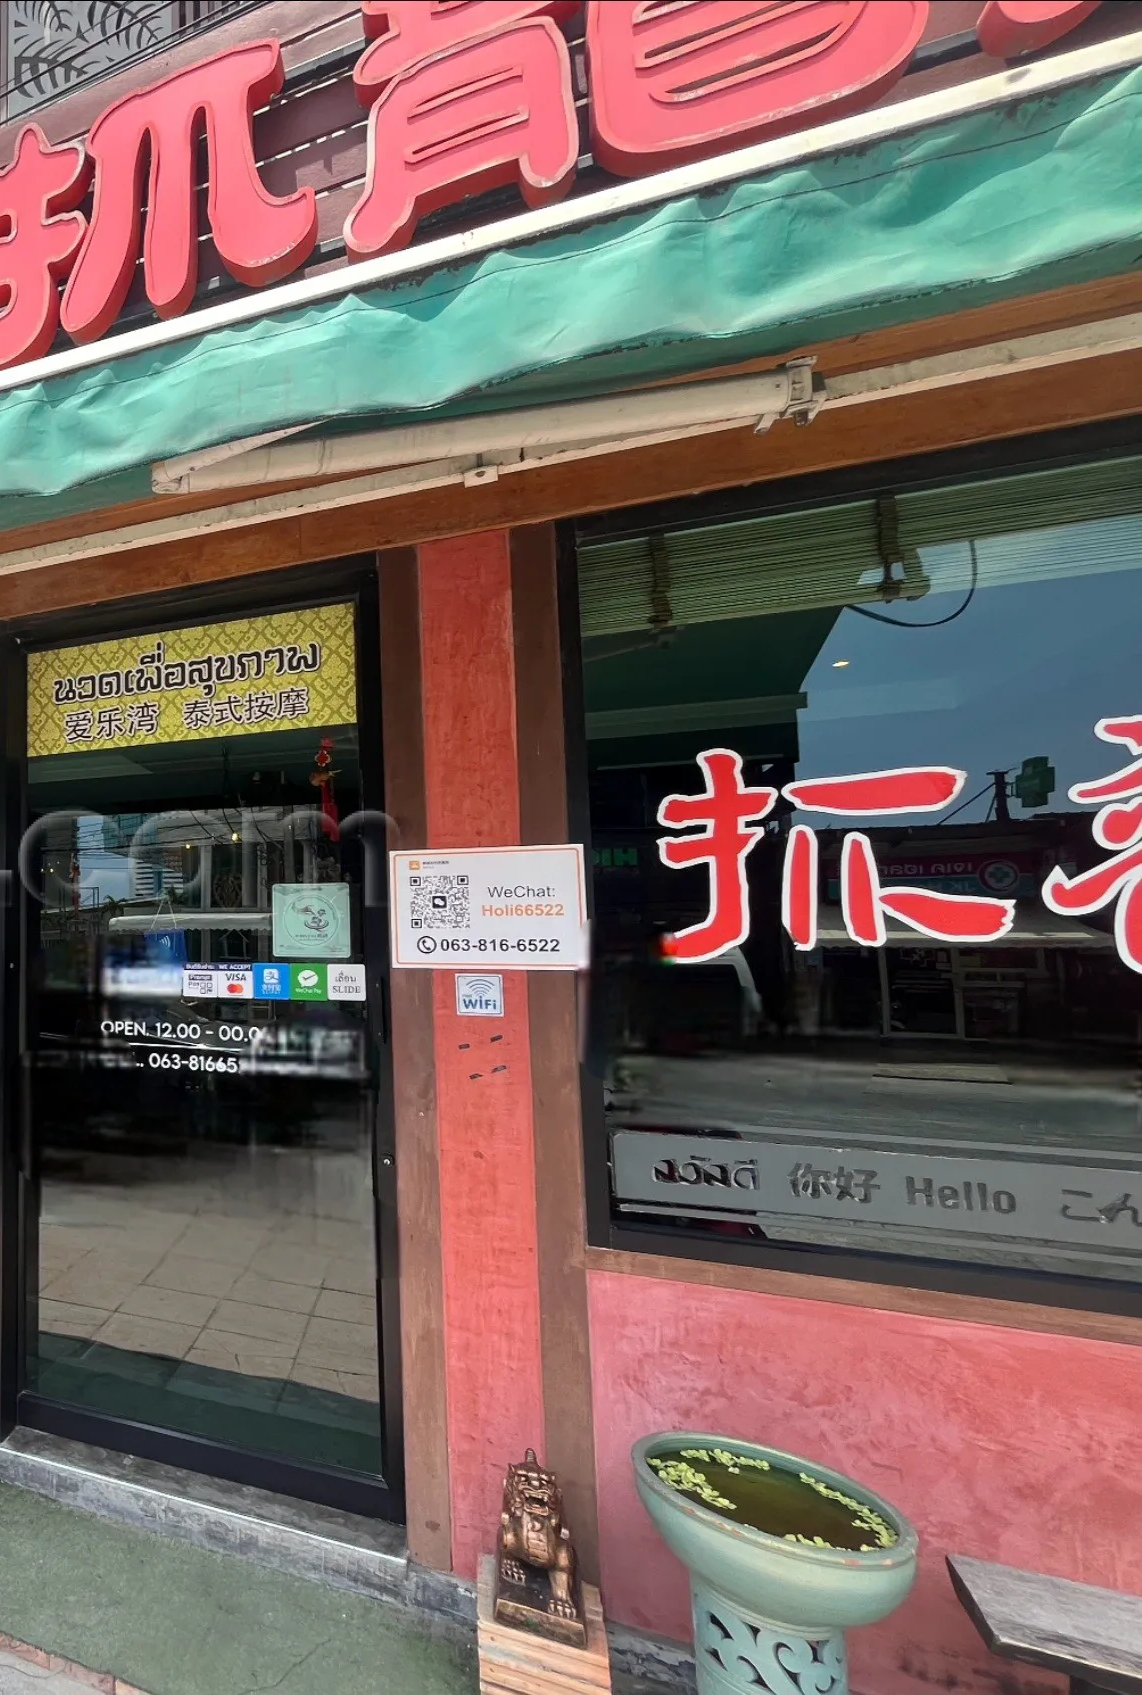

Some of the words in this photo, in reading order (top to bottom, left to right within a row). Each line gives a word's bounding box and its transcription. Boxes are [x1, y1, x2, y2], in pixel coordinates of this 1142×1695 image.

[53, 641, 322, 705] นวดเพื่อสุขภาพ
[64, 702, 159, 743] 爱乐湾
[183, 686, 309, 729] 泰式按摩
[487, 885, 556, 899] WeChat:
[481, 903, 565, 917] Holi66522
[440, 938, 561, 952] 063-816-6522
[225, 973, 247, 981] VISA
[335, 970, 357, 983] เลื่อน
[332, 985, 361, 994] SLIDE
[463, 996, 497, 1010] WiFi
[101, 1021, 150, 1037] OPEN.
[155, 1022, 201, 1039] 12.00
[787, 1162, 882, 1203] 你好
[904, 1175, 1017, 1214] Hello
